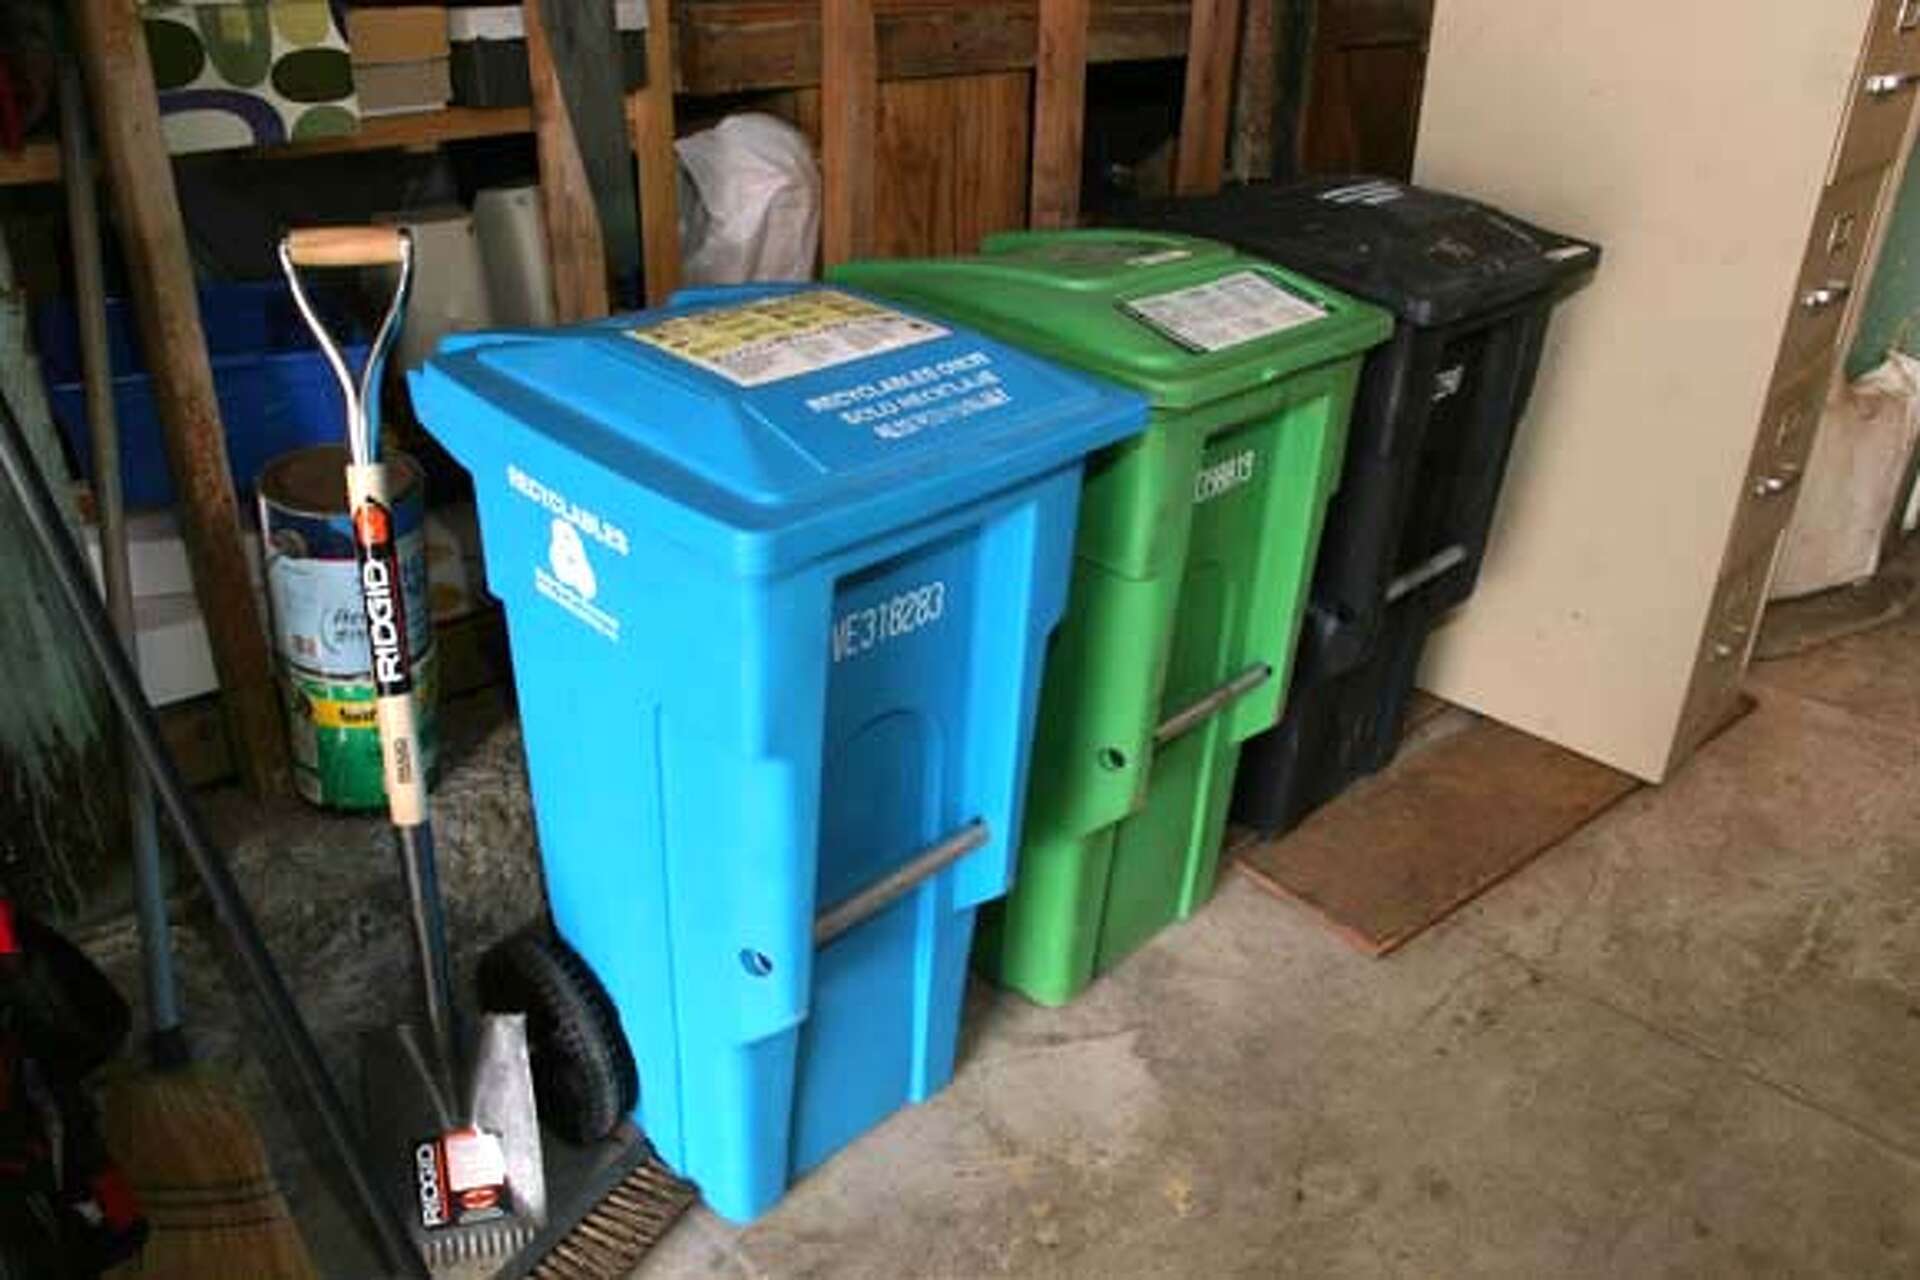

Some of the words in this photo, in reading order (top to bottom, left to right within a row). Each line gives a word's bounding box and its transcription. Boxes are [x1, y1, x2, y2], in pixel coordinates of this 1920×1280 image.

[507, 465, 629, 557] RECYCLABLES
[363, 558, 404, 682] RIDGID
[416, 1143, 446, 1227] RIDGID
